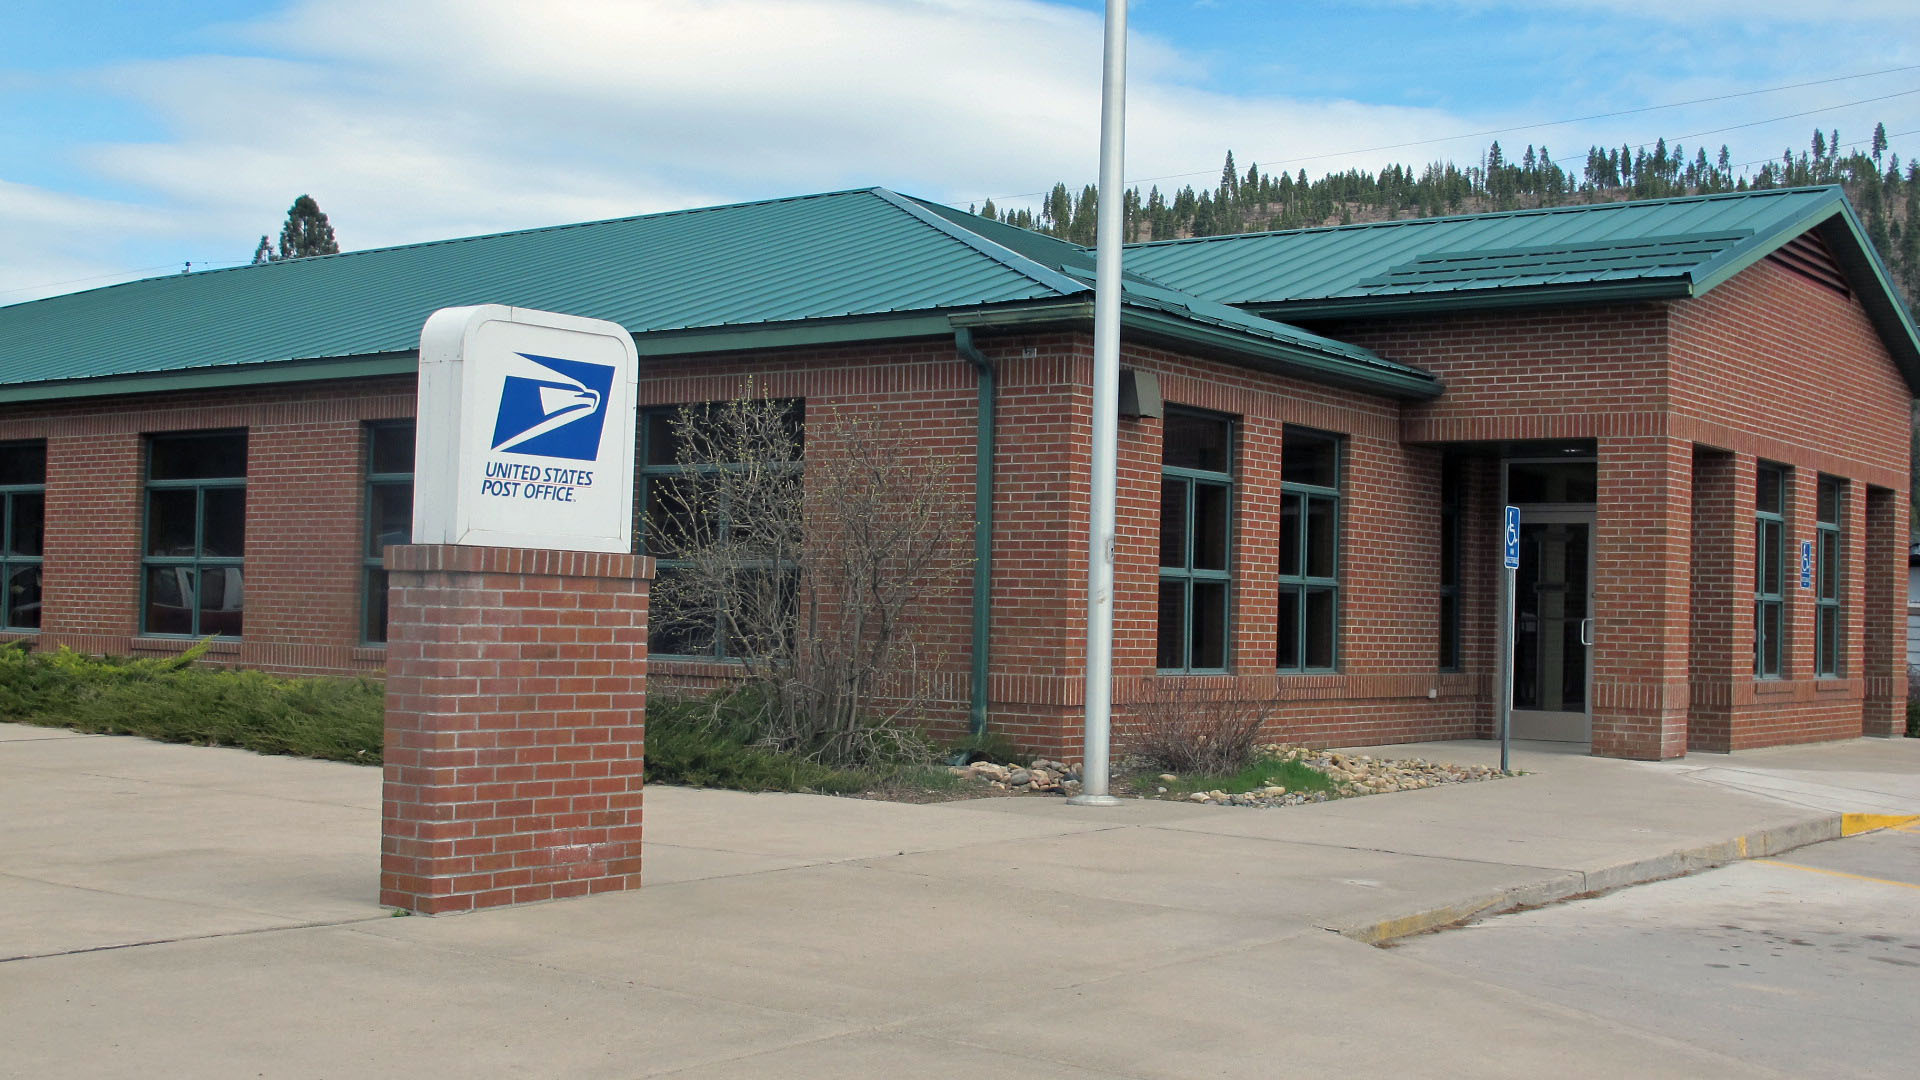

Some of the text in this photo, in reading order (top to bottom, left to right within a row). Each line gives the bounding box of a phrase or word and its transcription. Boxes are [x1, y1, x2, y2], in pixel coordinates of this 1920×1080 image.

[485, 461, 593, 486] UNITED STATES
[481, 479, 521, 498] POST
